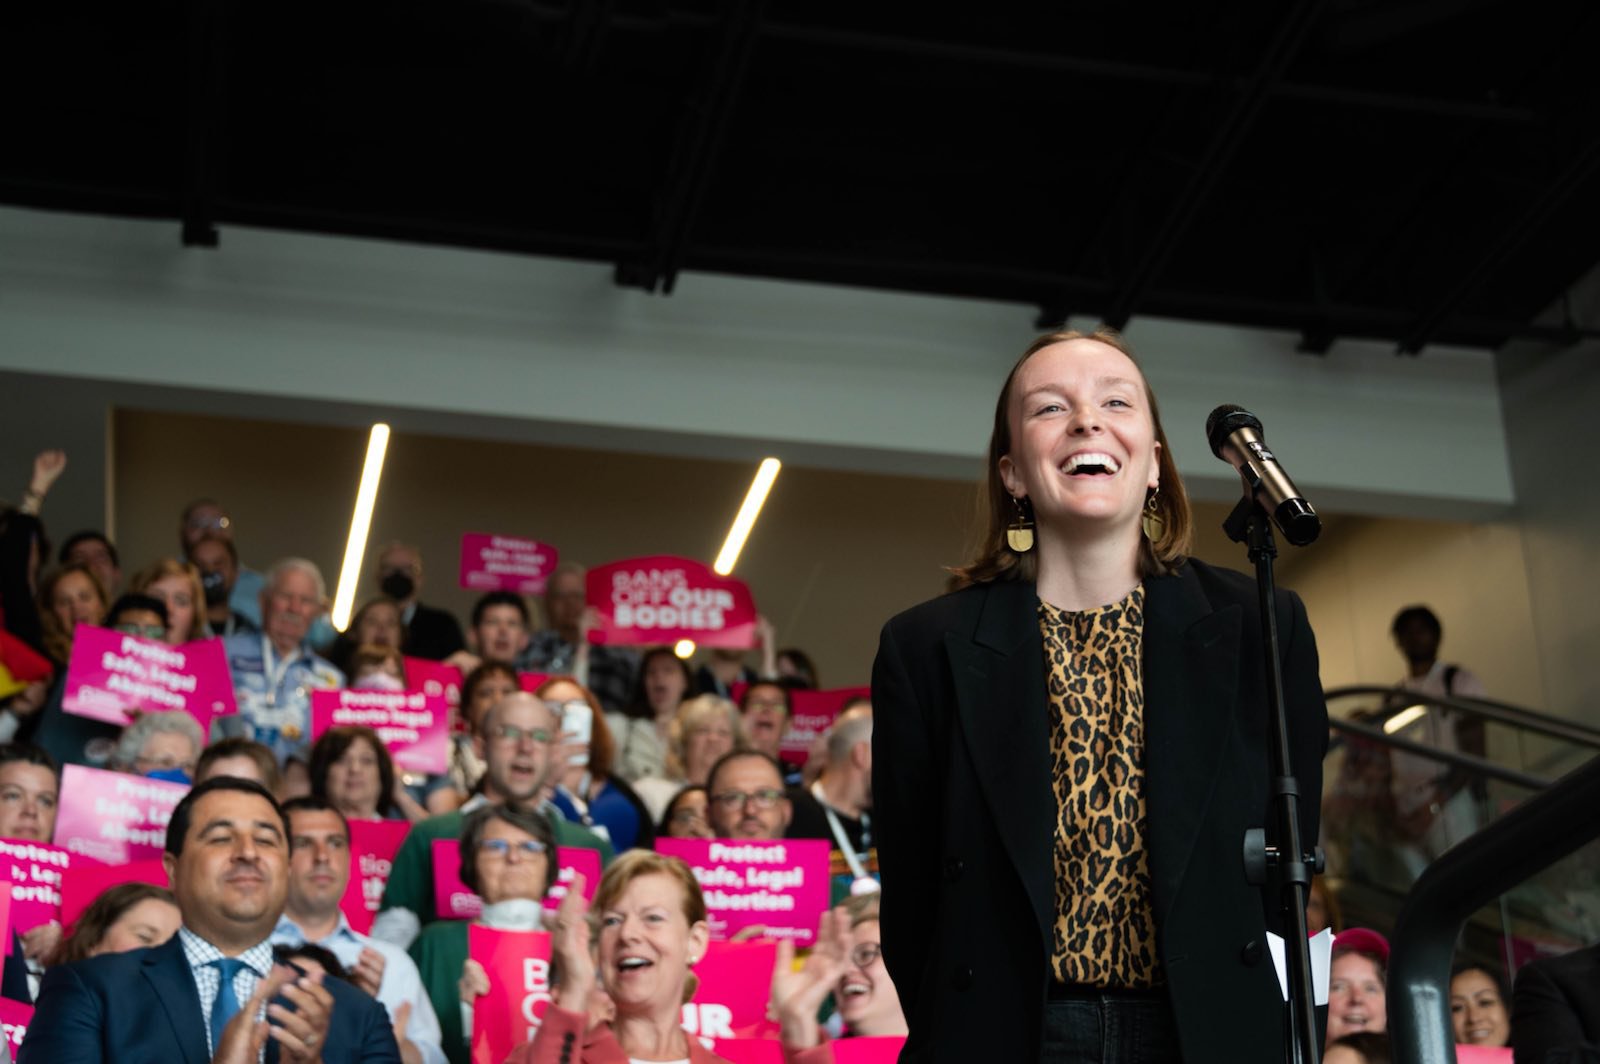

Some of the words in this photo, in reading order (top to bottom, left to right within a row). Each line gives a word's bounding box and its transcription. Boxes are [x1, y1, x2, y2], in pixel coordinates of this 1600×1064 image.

[612, 568, 688, 592] BANS
[668, 586, 735, 610] OUR
[614, 603, 725, 630] BODIES
[709, 843, 787, 863] Protect
[746, 866, 804, 891] Legal
